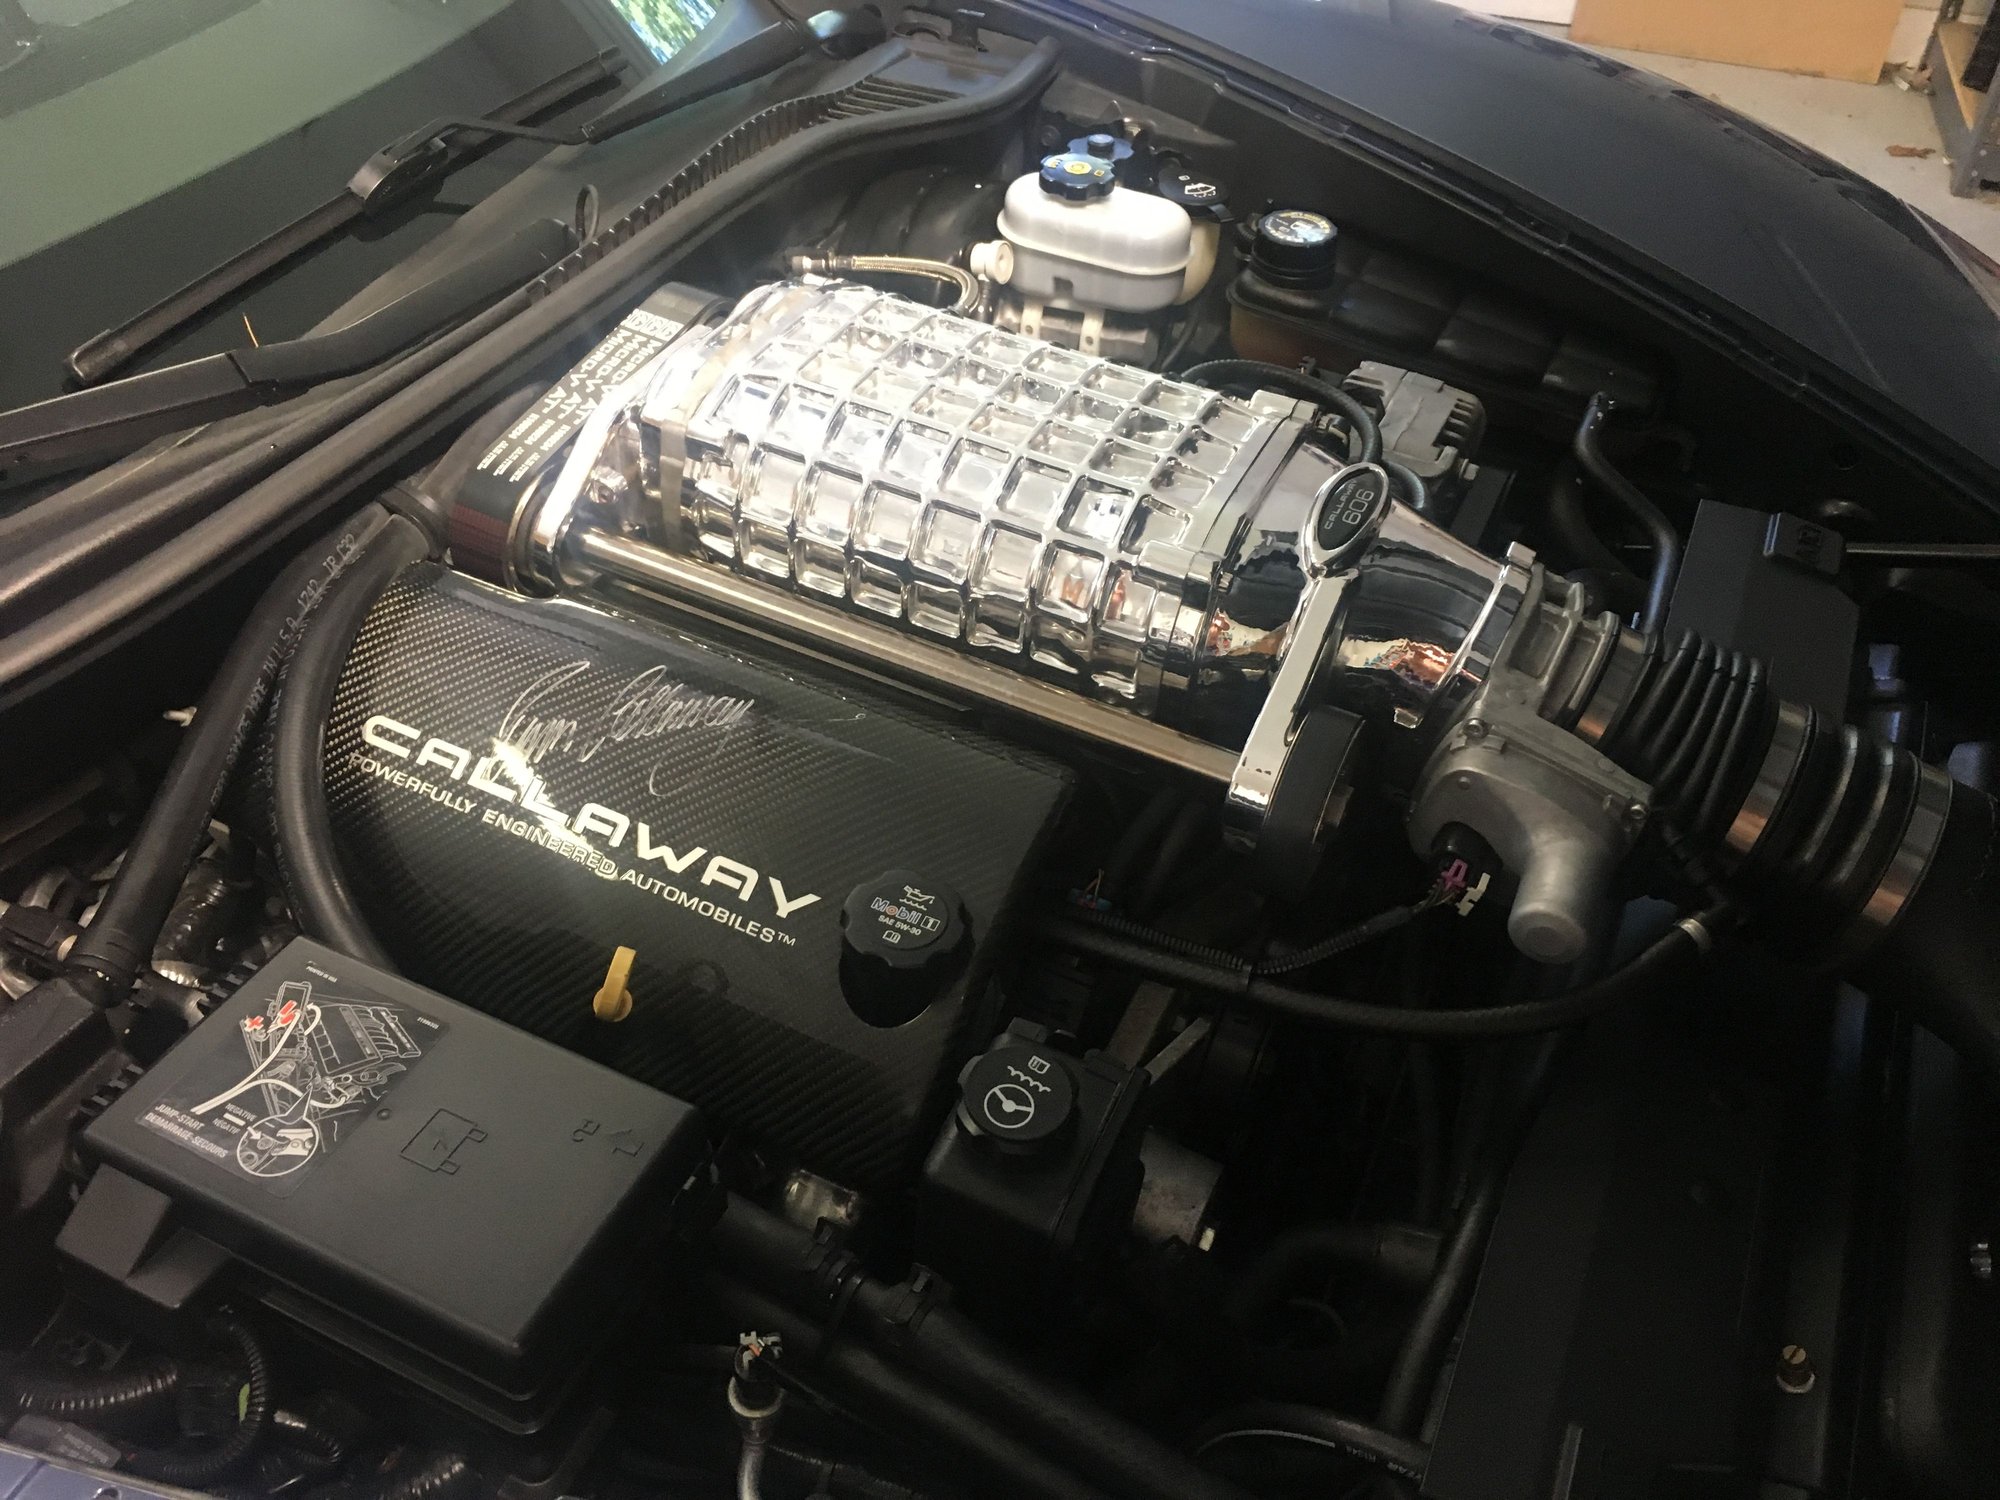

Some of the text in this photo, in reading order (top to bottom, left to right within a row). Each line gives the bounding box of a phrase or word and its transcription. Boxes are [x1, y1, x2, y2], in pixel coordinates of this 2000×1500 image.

[1324, 480, 1357, 530] CALLAWAY
[1342, 488, 1374, 525] 606
[348, 751, 477, 814] POWERFULLY
[482, 808, 617, 876] ENGINEERED
[362, 715, 822, 919] CALLAWAY
[871, 897, 922, 925] Mobil
[878, 915, 922, 936] SAE 5W-30
[155, 1104, 205, 1130] JUMP-START
[224, 1103, 258, 1122] NEGATIVE
